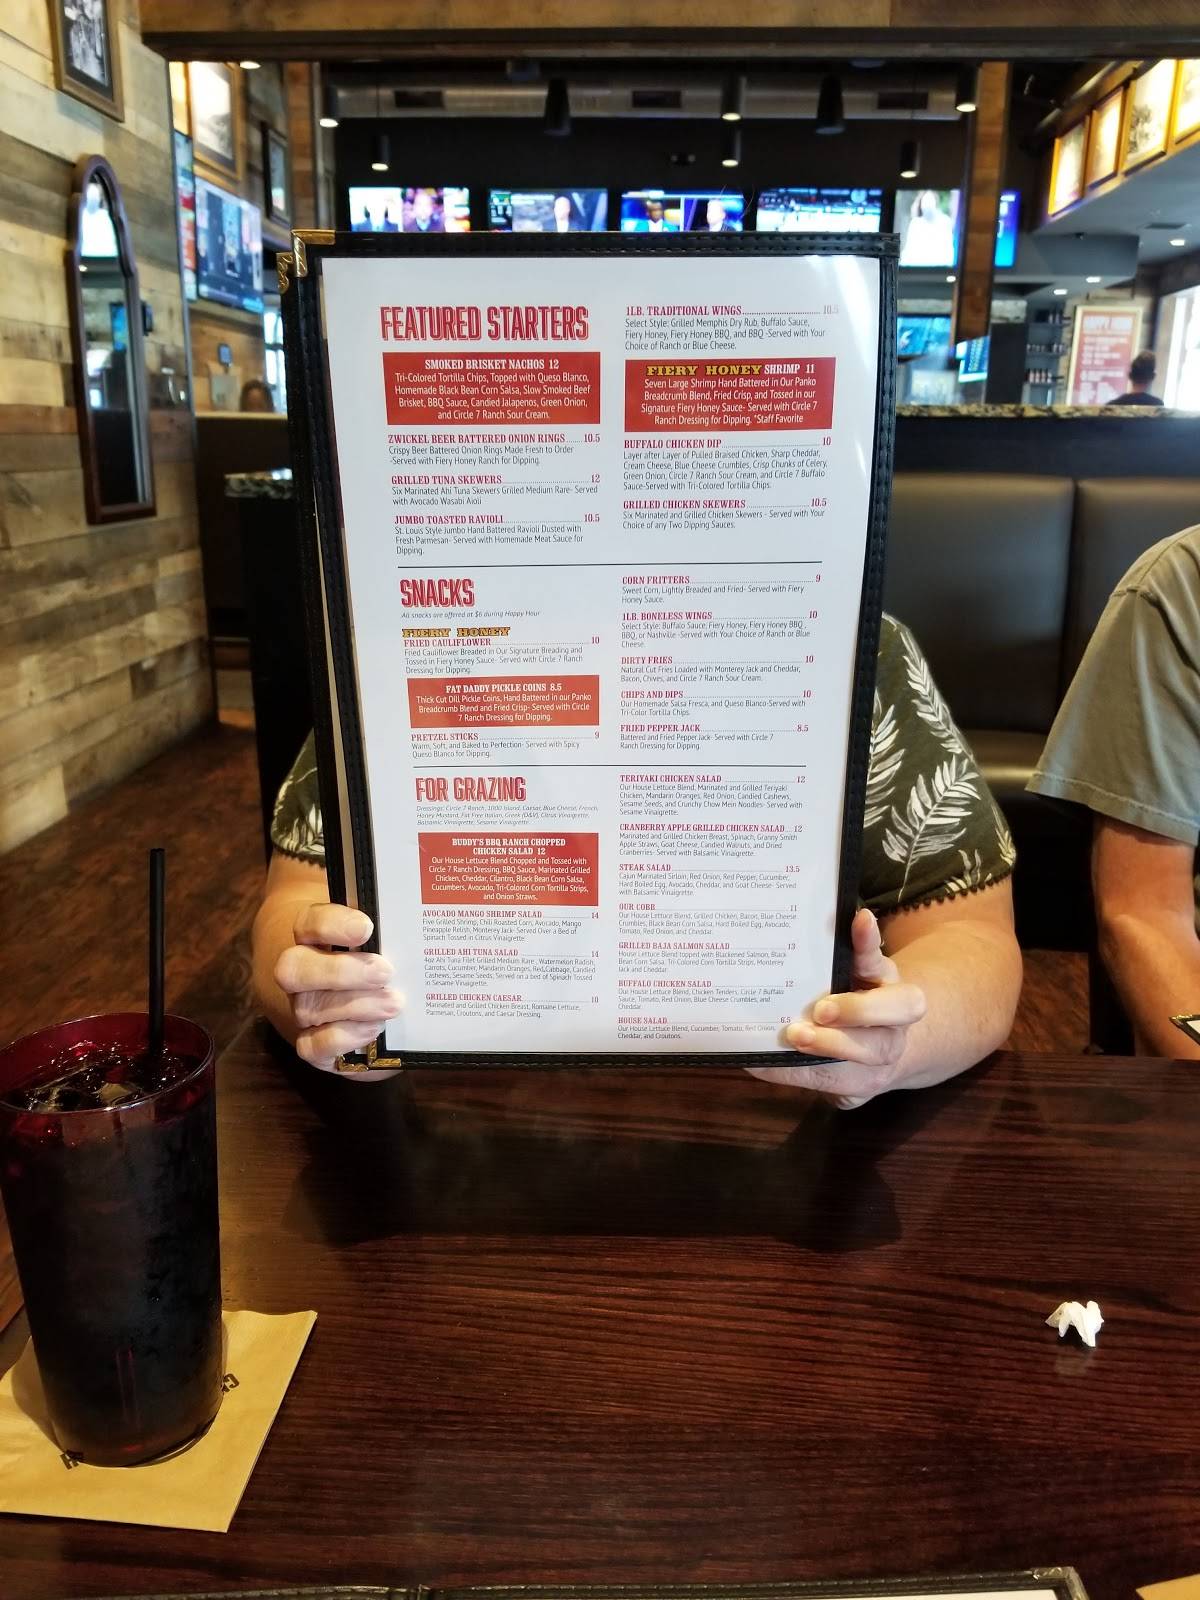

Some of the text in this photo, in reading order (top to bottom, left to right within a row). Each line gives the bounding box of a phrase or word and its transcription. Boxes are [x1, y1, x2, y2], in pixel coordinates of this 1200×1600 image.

[626, 306, 644, 316] 1LB.
[648, 306, 709, 315] TRADITIONAL
[712, 306, 742, 315] WINGS
[381, 306, 588, 340] FEATURED STARTERS
[425, 359, 559, 369] SMOKED BRISKET NACHOS 12
[646, 364, 814, 376] FIERY HONEY SHRIMP 11
[395, 373, 589, 382] Tri-Colored Tortilla Chips, Topped with Queso Blanco,
[438, 411, 549, 419] and Circle 7 Ranch Sour Cream.
[655, 415, 677, 425] Ranch
[679, 415, 709, 425] Dressing
[711, 415, 721, 424] for
[723, 415, 751, 424] Dipping.
[776, 414, 803, 424] Favorite
[389, 434, 600, 443] ZWICKEL BEER BATTERED ONION RINGS 10.5
[625, 437, 831, 448] BUFFALO CHICKEN DIP 10
[392, 475, 600, 484] GRILLED TUNA SKEWERS 12
[393, 497, 481, 505] with Avocado Wasabi Aioli
[624, 498, 826, 509] GRILLED CHICKEN SKEWERS 10.5
[395, 514, 599, 524] JUMBO TOASTED RAVIOLI 10.5
[623, 575, 820, 584] CORN FRITTERS 9
[400, 579, 475, 607] SNACKS
[641, 612, 683, 620] BONELESS
[686, 612, 712, 620] WINGS
[809, 611, 817, 619] 10
[402, 627, 510, 637] FIERY HONEY
[432, 638, 491, 646] CAULIFLOWER
[446, 685, 461, 693] FAT
[492, 684, 521, 692] PICKLE
[523, 684, 546, 692] COINS
[450, 733, 478, 741] STICKS
[660, 775, 695, 783] CHICKEN
[696, 775, 721, 783] SALAD
[416, 777, 526, 801] FOR GRAZING
[620, 824, 666, 832] CRANBERRY
